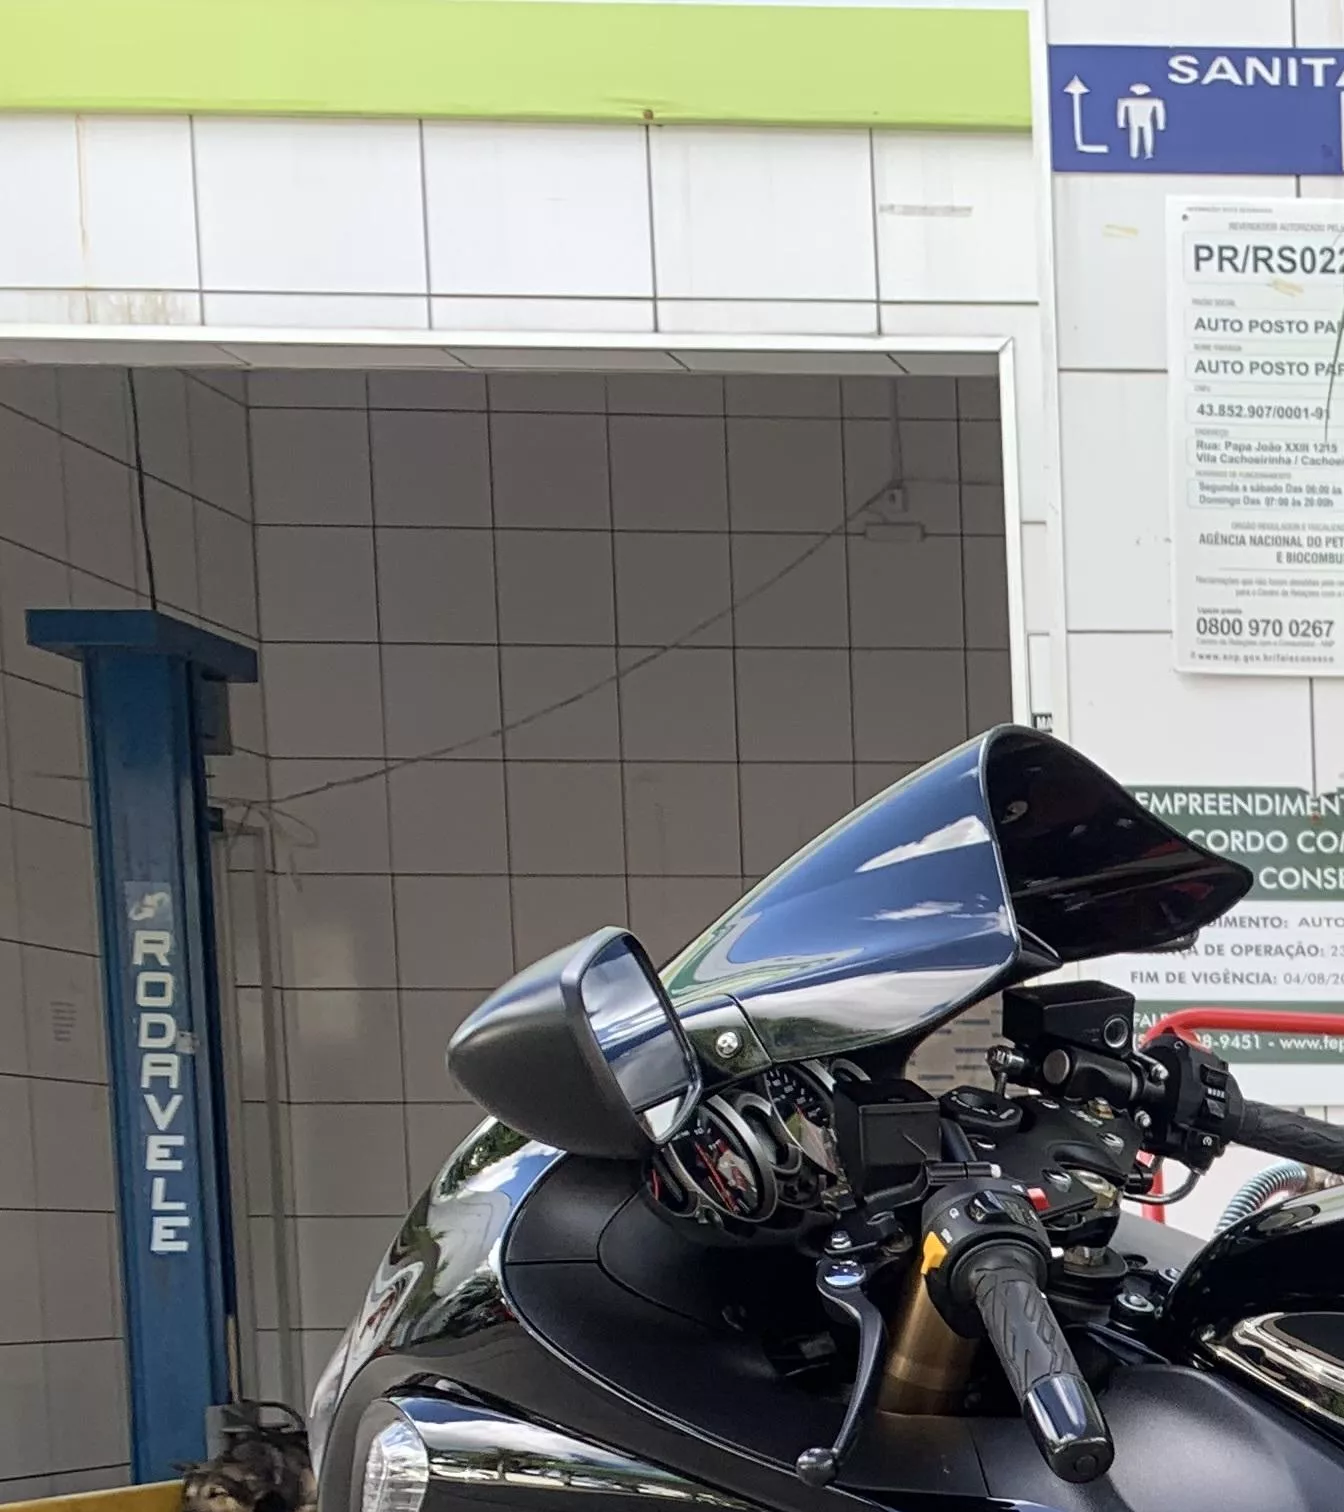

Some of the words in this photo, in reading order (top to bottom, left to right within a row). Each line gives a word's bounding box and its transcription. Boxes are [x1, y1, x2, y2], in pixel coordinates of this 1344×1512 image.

[1194, 316, 1243, 332] AUTO
[1249, 319, 1309, 334] POSTO
[1194, 359, 1244, 375] AUTO
[1249, 361, 1310, 376] POSTO
[1199, 531, 1246, 547] AGÊNCIA
[1249, 534, 1303, 548] NACIONAL
[1306, 535, 1323, 548] DO
[1276, 551, 1283, 564] E
[1196, 617, 1243, 636] 0800
[1248, 619, 1283, 637] 970
[1288, 620, 1334, 638] 0267
[1187, 829, 1289, 853] CORDO
[1204, 943, 1225, 956] DE
[1230, 939, 1326, 960] OPERAÇÃO:
[1130, 971, 1160, 984] FIM
[1165, 971, 1187, 985] DE
[1192, 967, 1278, 985] VIGÊNCIA:
[132, 930, 190, 1253] RODAVELE
